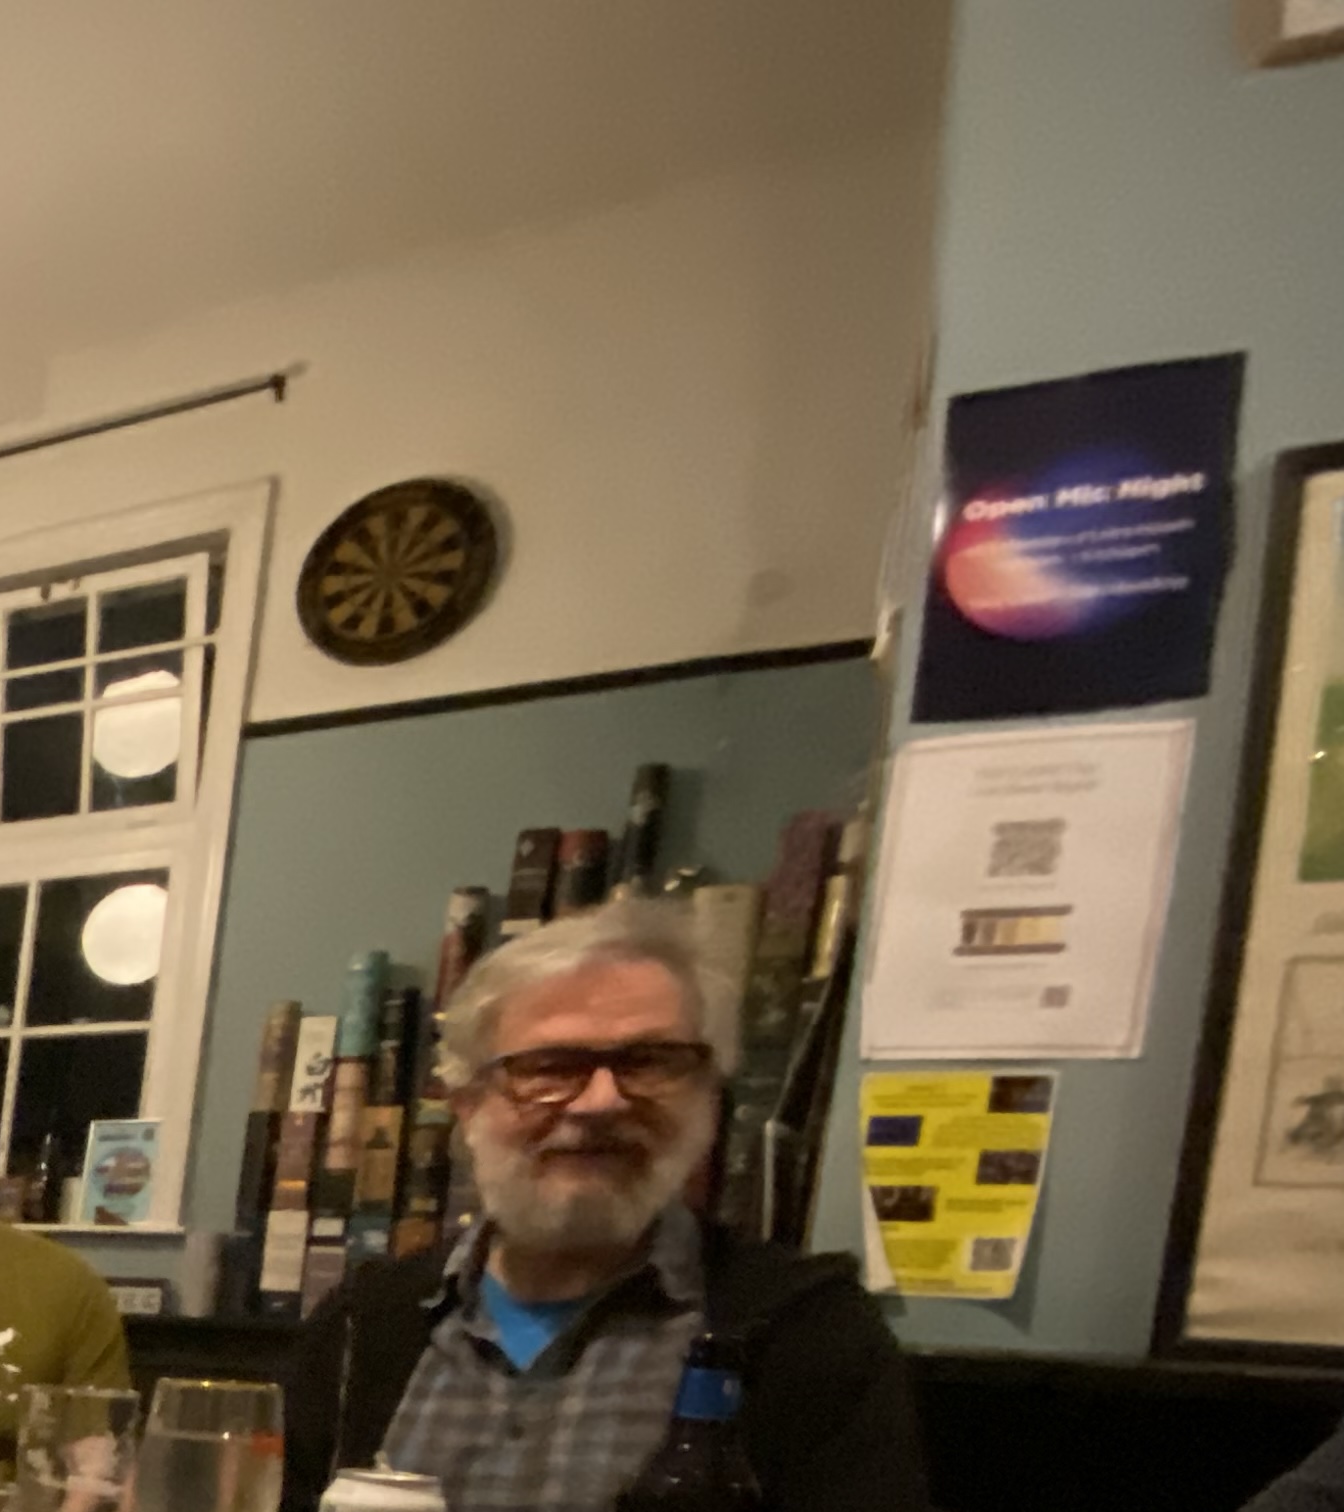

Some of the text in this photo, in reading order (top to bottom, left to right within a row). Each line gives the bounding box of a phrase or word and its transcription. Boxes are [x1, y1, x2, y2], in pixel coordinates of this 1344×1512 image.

[962, 471, 1206, 523] Open Mic Night
